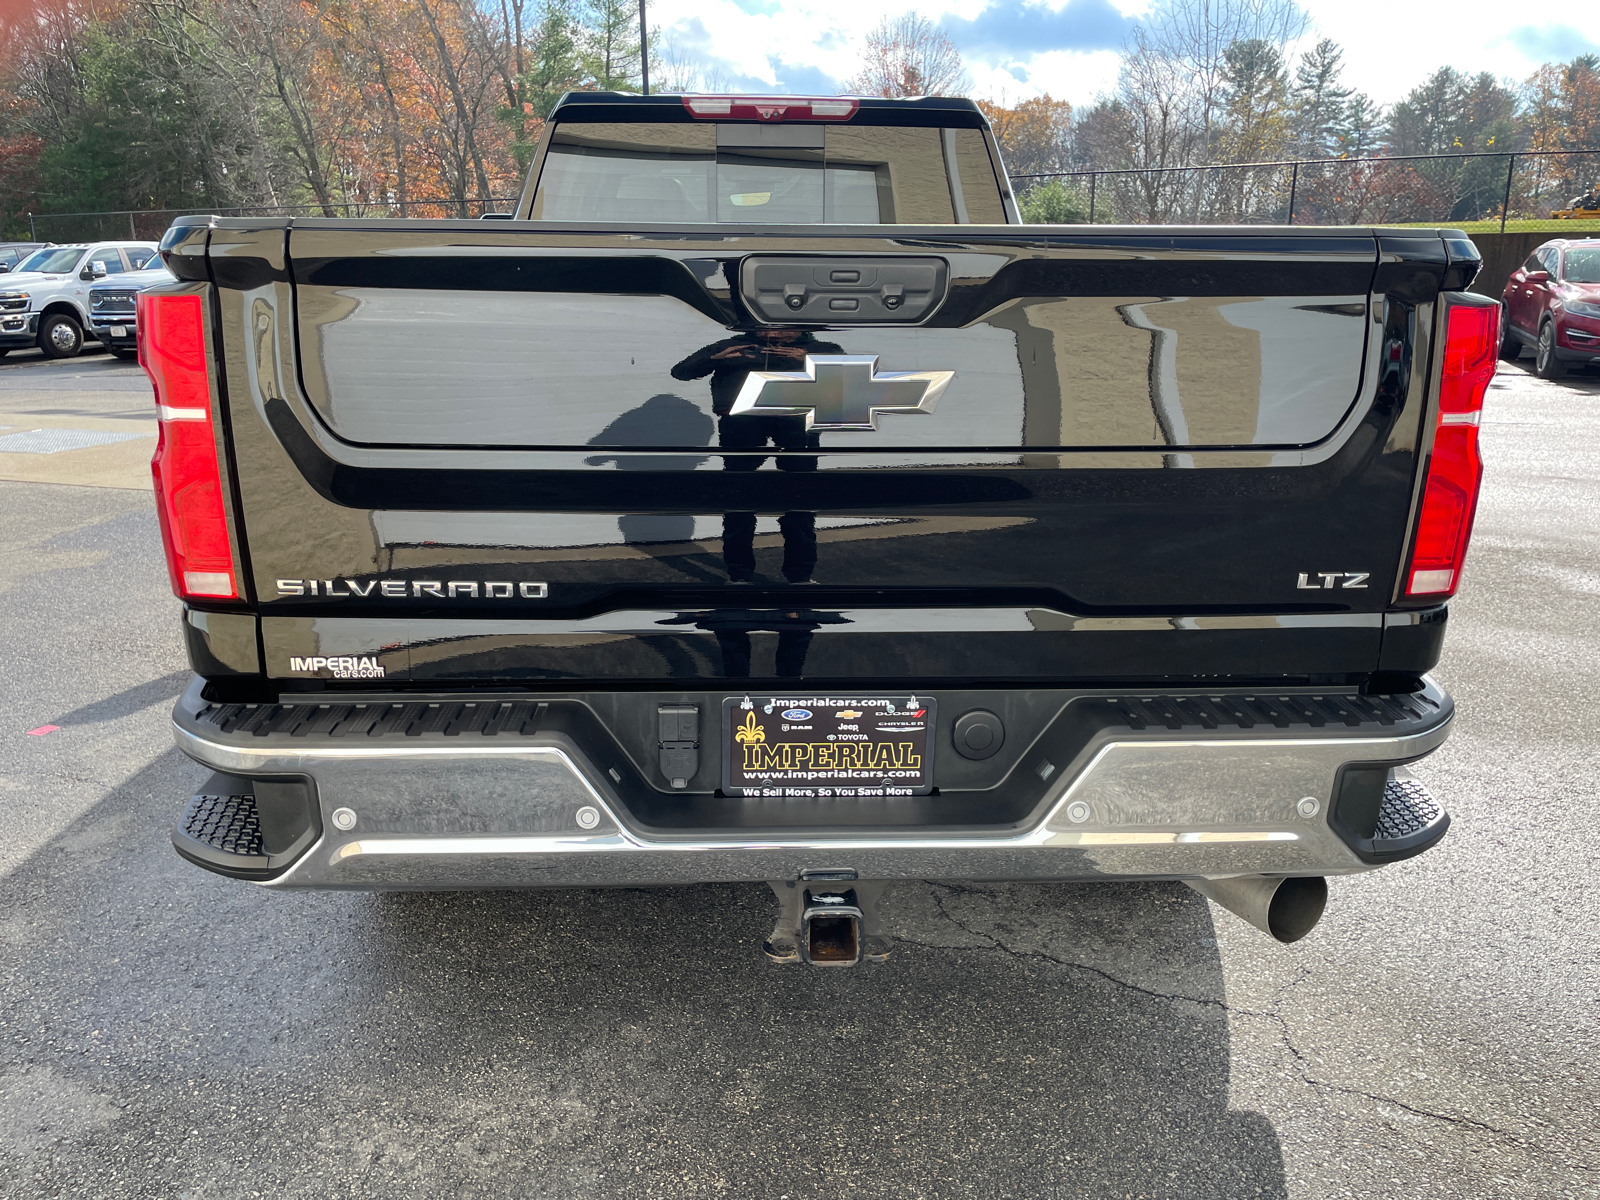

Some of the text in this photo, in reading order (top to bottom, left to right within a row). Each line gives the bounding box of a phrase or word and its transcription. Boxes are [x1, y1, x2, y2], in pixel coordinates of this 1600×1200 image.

[1296, 572, 1370, 589] LTZ
[276, 579, 550, 598] SILVERADO
[289, 656, 384, 671] IMPERIAL
[333, 669, 385, 678] cars.com
[770, 697, 890, 708] Imperialcars.com
[838, 722, 858, 731] Jeep
[743, 742, 921, 770] IMPERIAL
[743, 769, 921, 780] www.imperialcars.com
[743, 788, 913, 798] We Sell More, So You Save More
